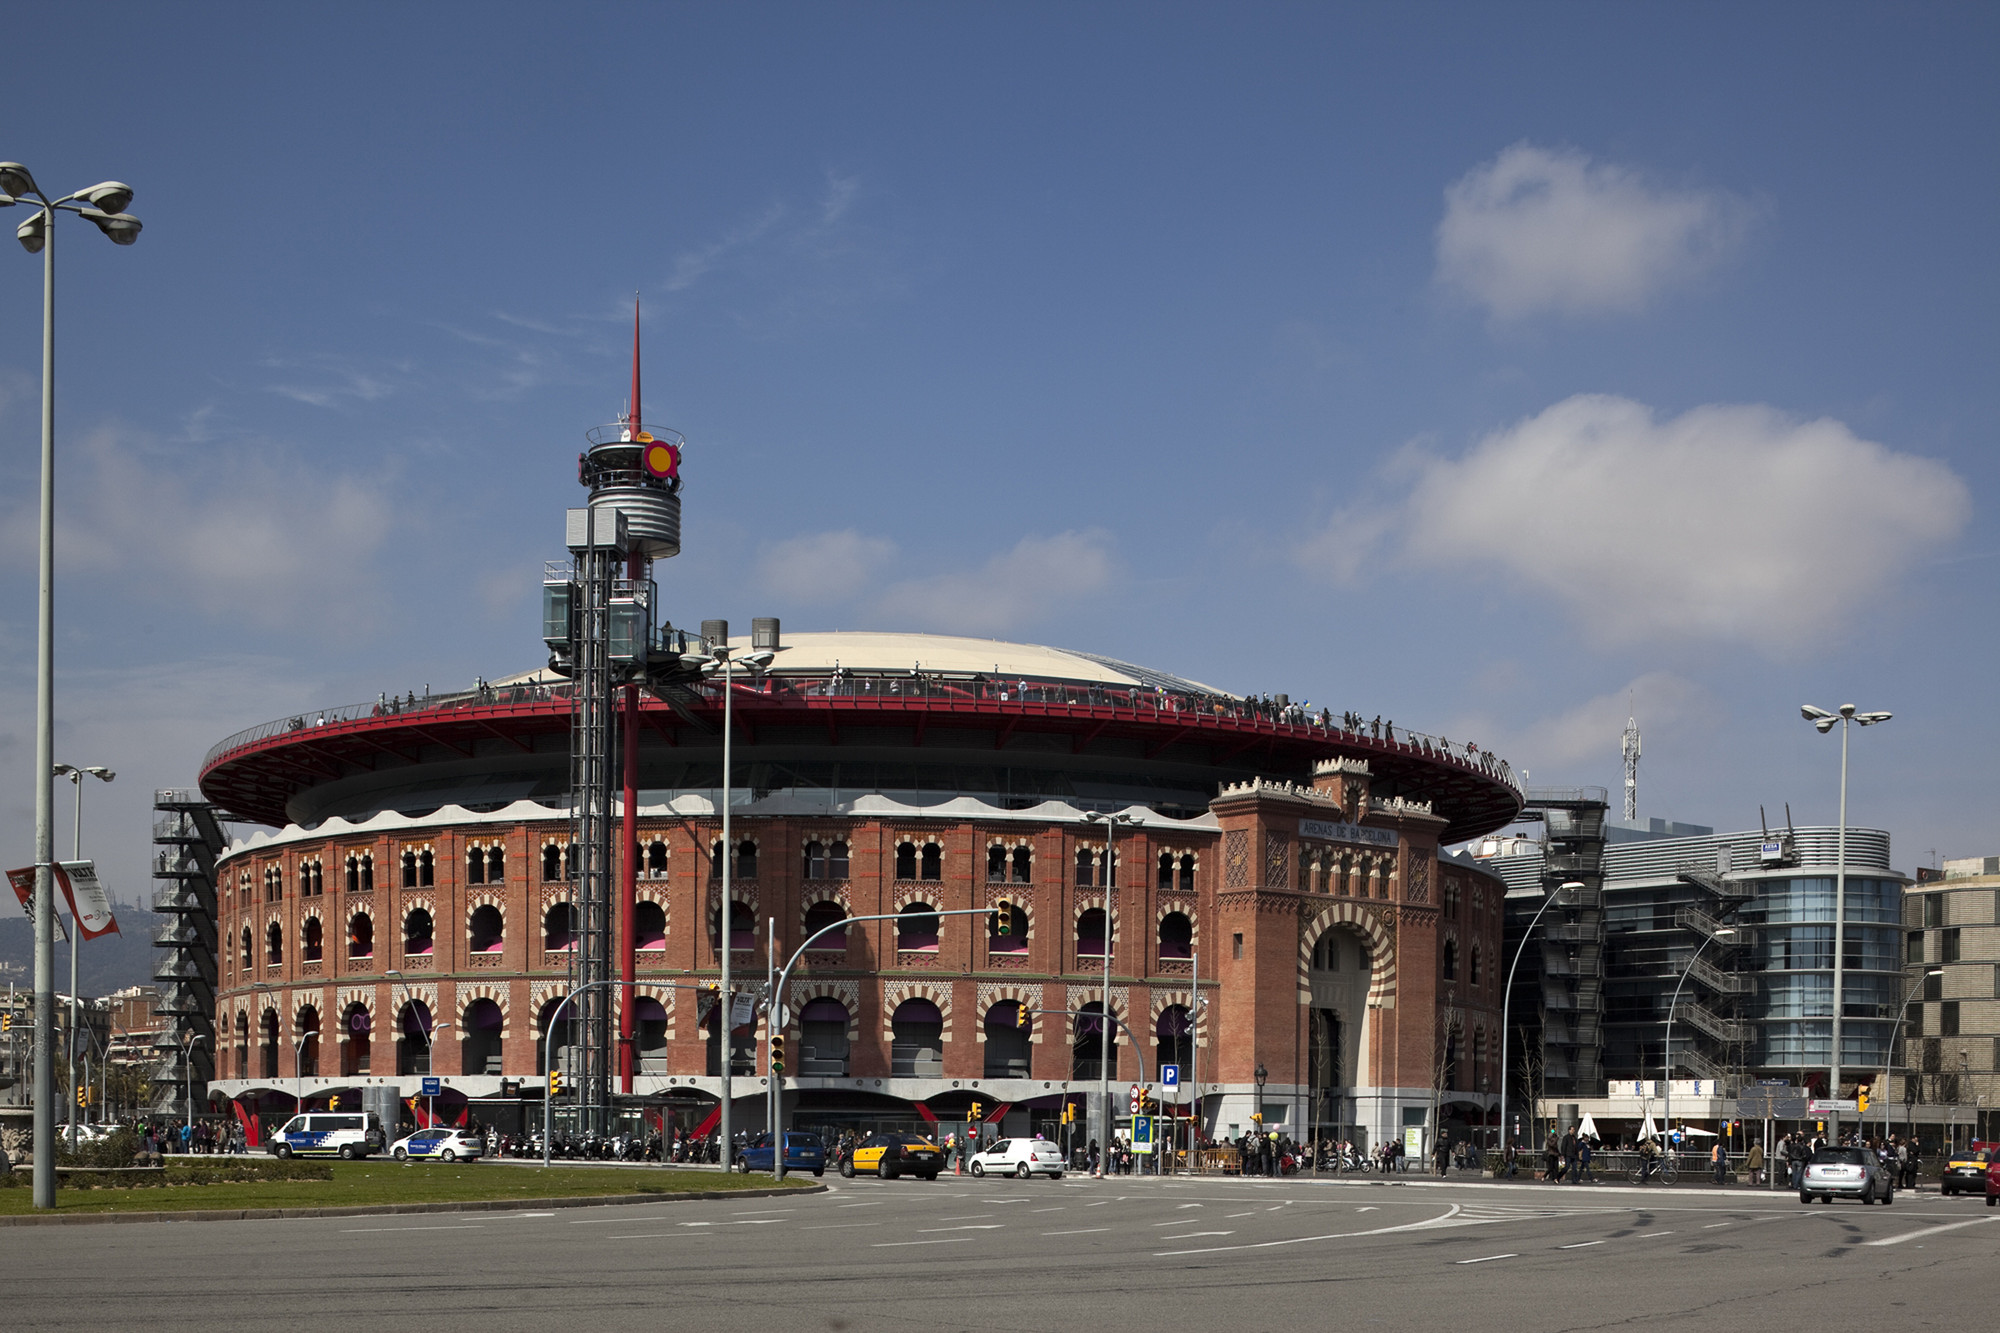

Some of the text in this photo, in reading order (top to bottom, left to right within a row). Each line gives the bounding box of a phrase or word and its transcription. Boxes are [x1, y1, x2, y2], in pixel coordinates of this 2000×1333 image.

[1304, 822, 1392, 843] ARENAS DE BARCELONA
[1166, 1068, 1175, 1082] P
[1138, 1119, 1147, 1130] P
